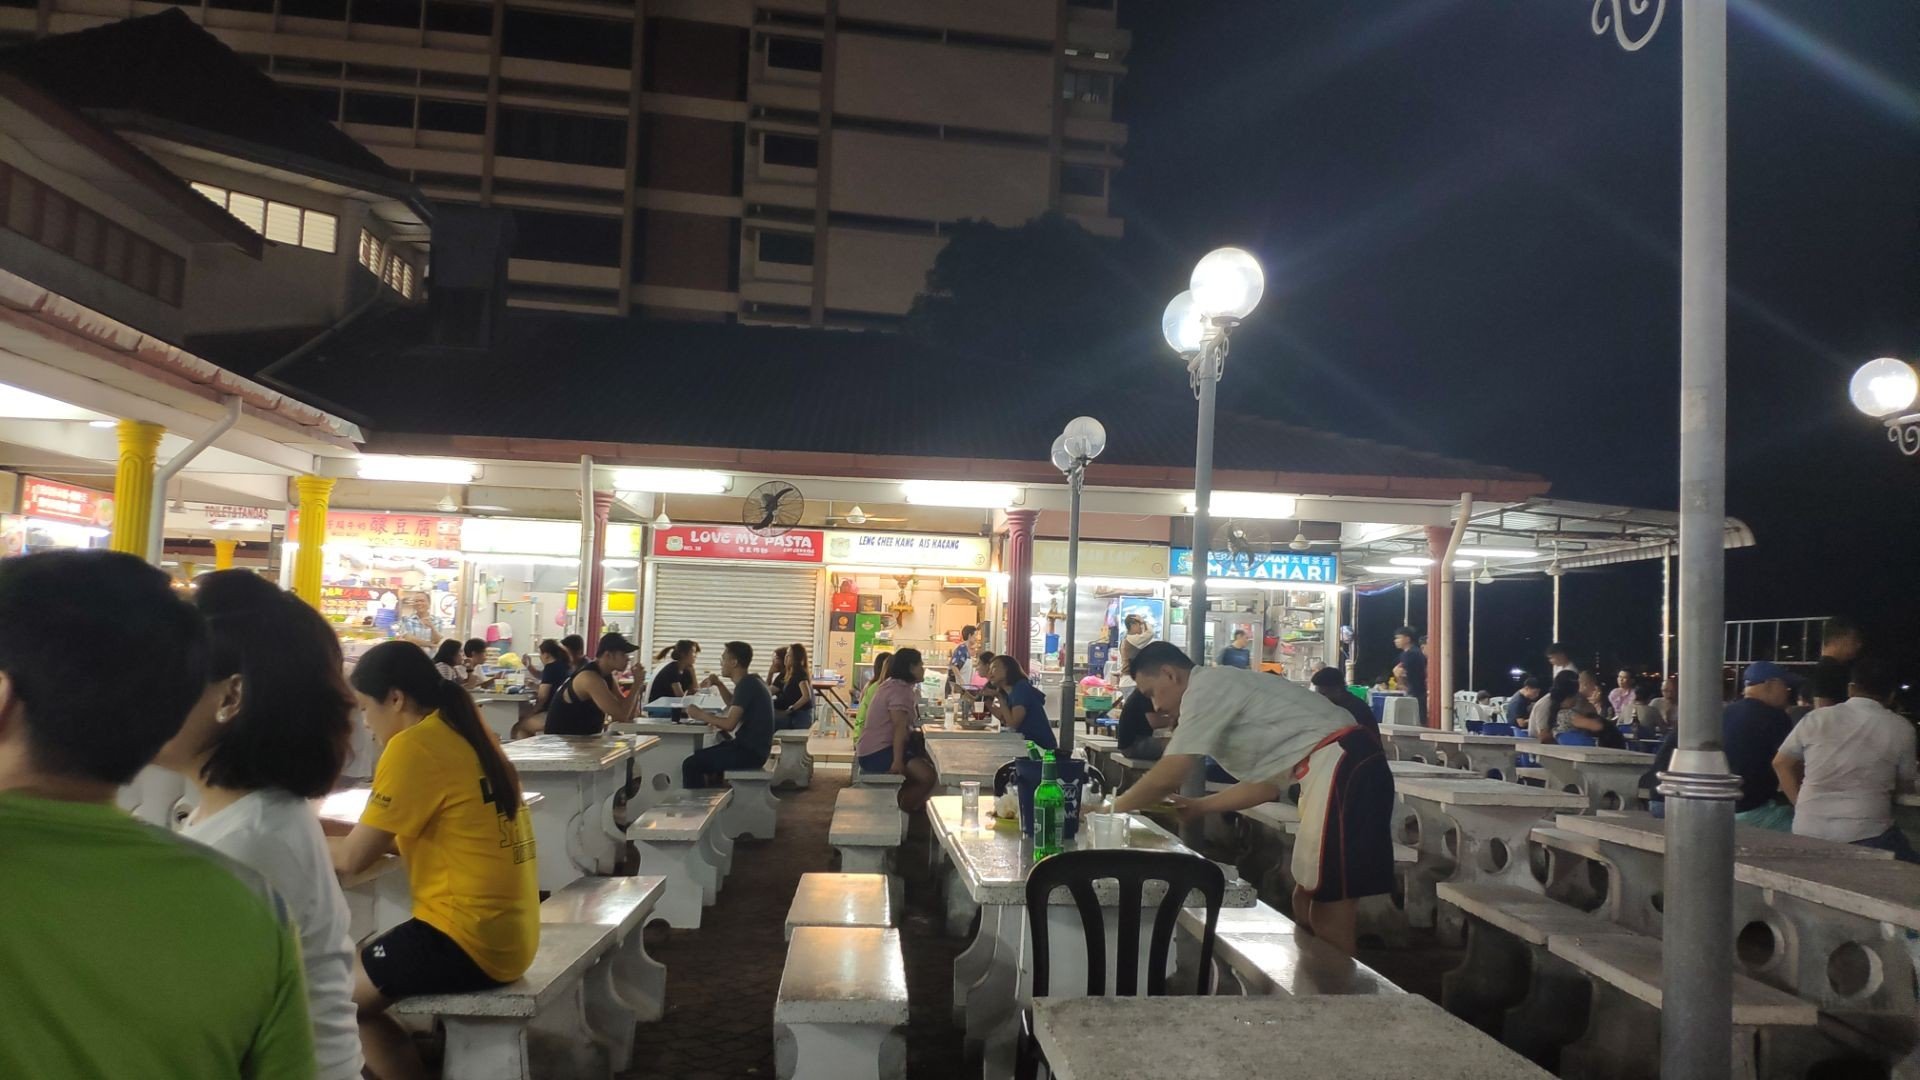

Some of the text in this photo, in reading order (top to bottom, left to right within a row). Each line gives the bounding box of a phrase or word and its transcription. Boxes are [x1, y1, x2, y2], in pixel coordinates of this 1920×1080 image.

[690, 530, 813, 548] LOVE MY PASTA
[858, 535, 960, 550] LENG CHEE KANG AIS KACANG
[1207, 562, 1331, 581] MATAHARI
